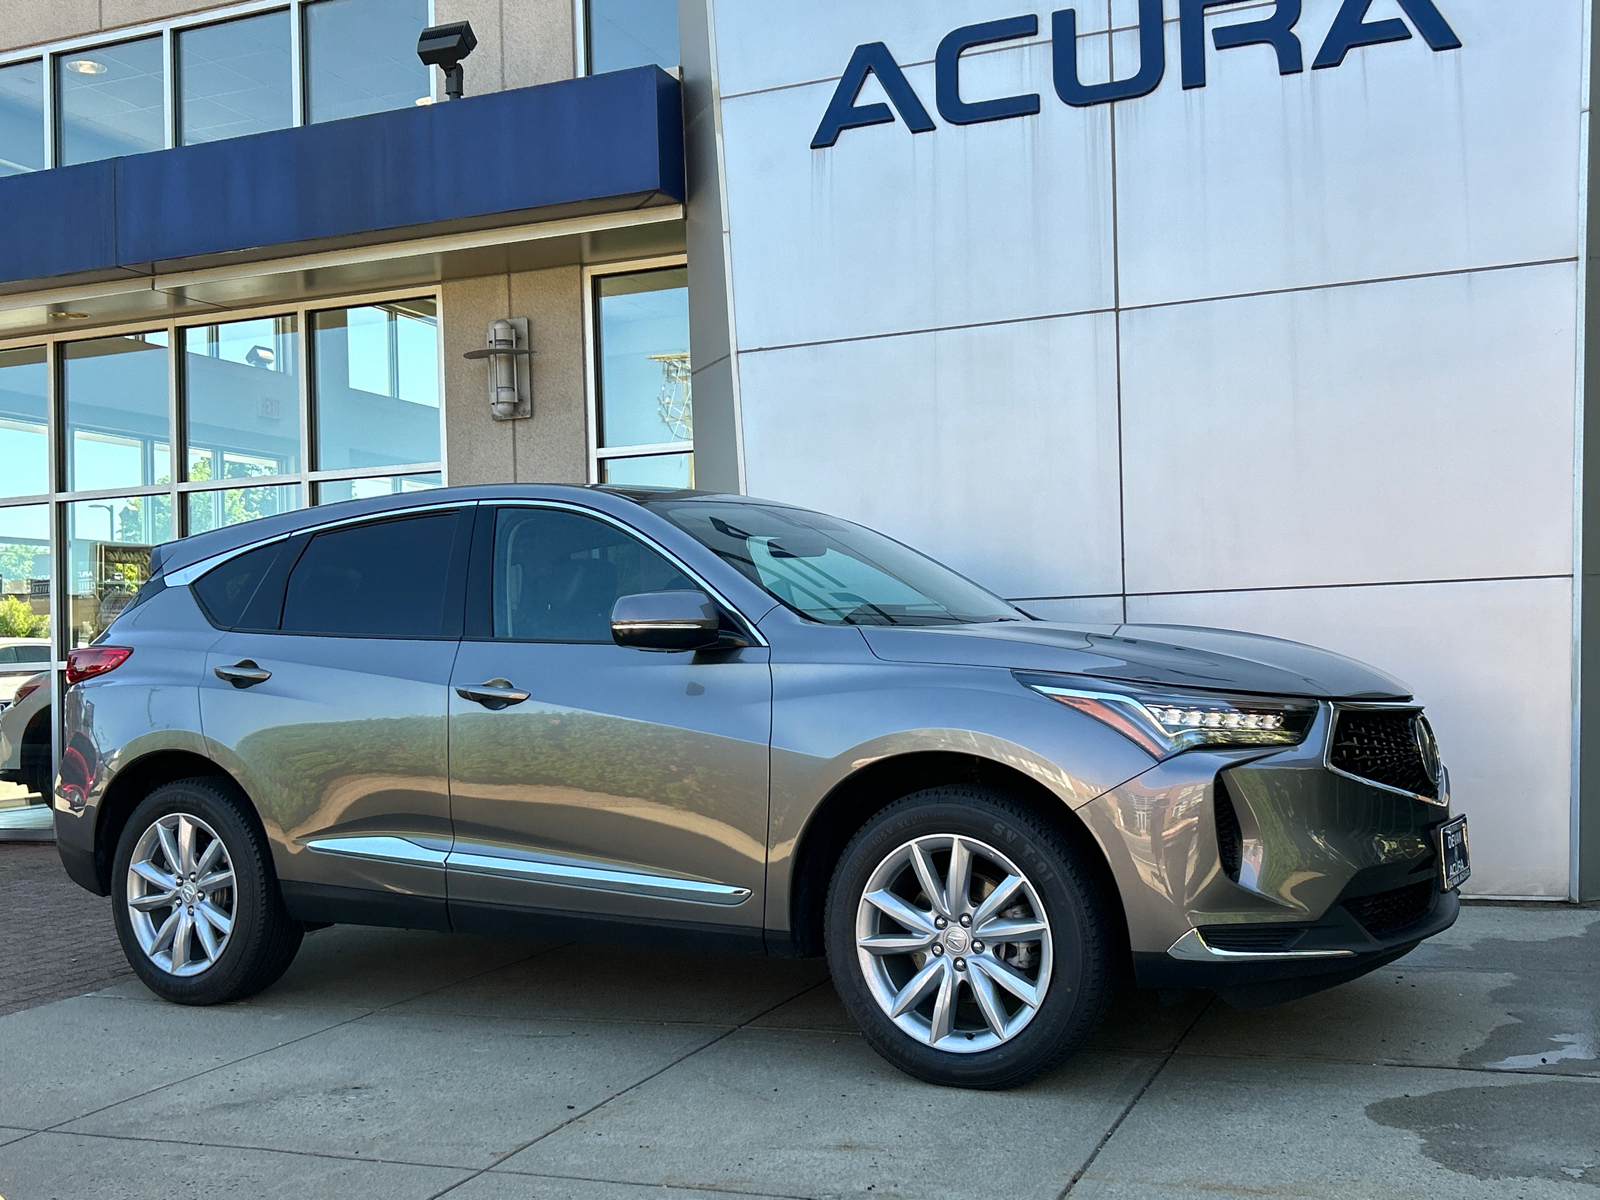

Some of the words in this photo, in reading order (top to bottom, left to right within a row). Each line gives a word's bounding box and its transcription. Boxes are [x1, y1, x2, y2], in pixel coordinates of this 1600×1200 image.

[810, 0, 1462, 149] ACURA
[992, 821, 1018, 845] SV
[1021, 843, 1055, 883] T-01
